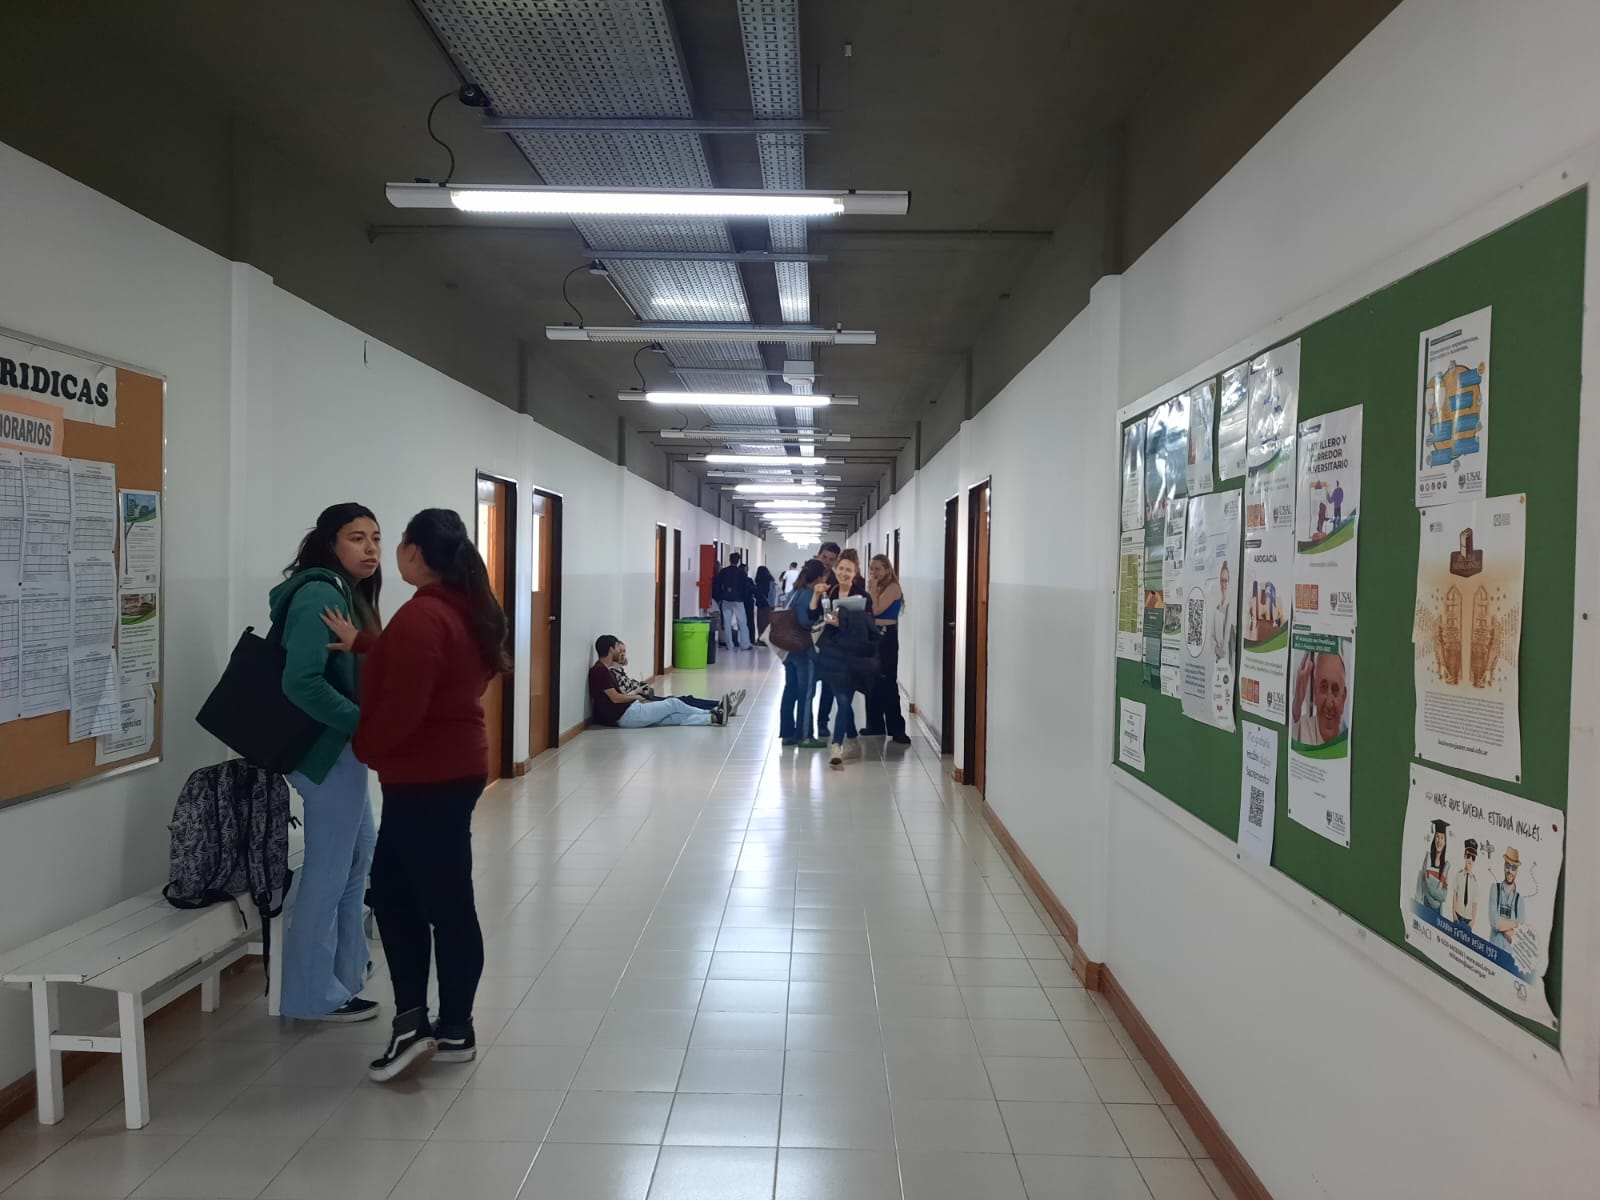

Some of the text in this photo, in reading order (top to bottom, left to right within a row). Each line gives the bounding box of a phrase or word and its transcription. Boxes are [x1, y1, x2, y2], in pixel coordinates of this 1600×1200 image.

[0, 357, 109, 407] RIDICAS
[1448, 798, 1460, 812] QUE
[1516, 820, 1542, 842] INGLÉS.
